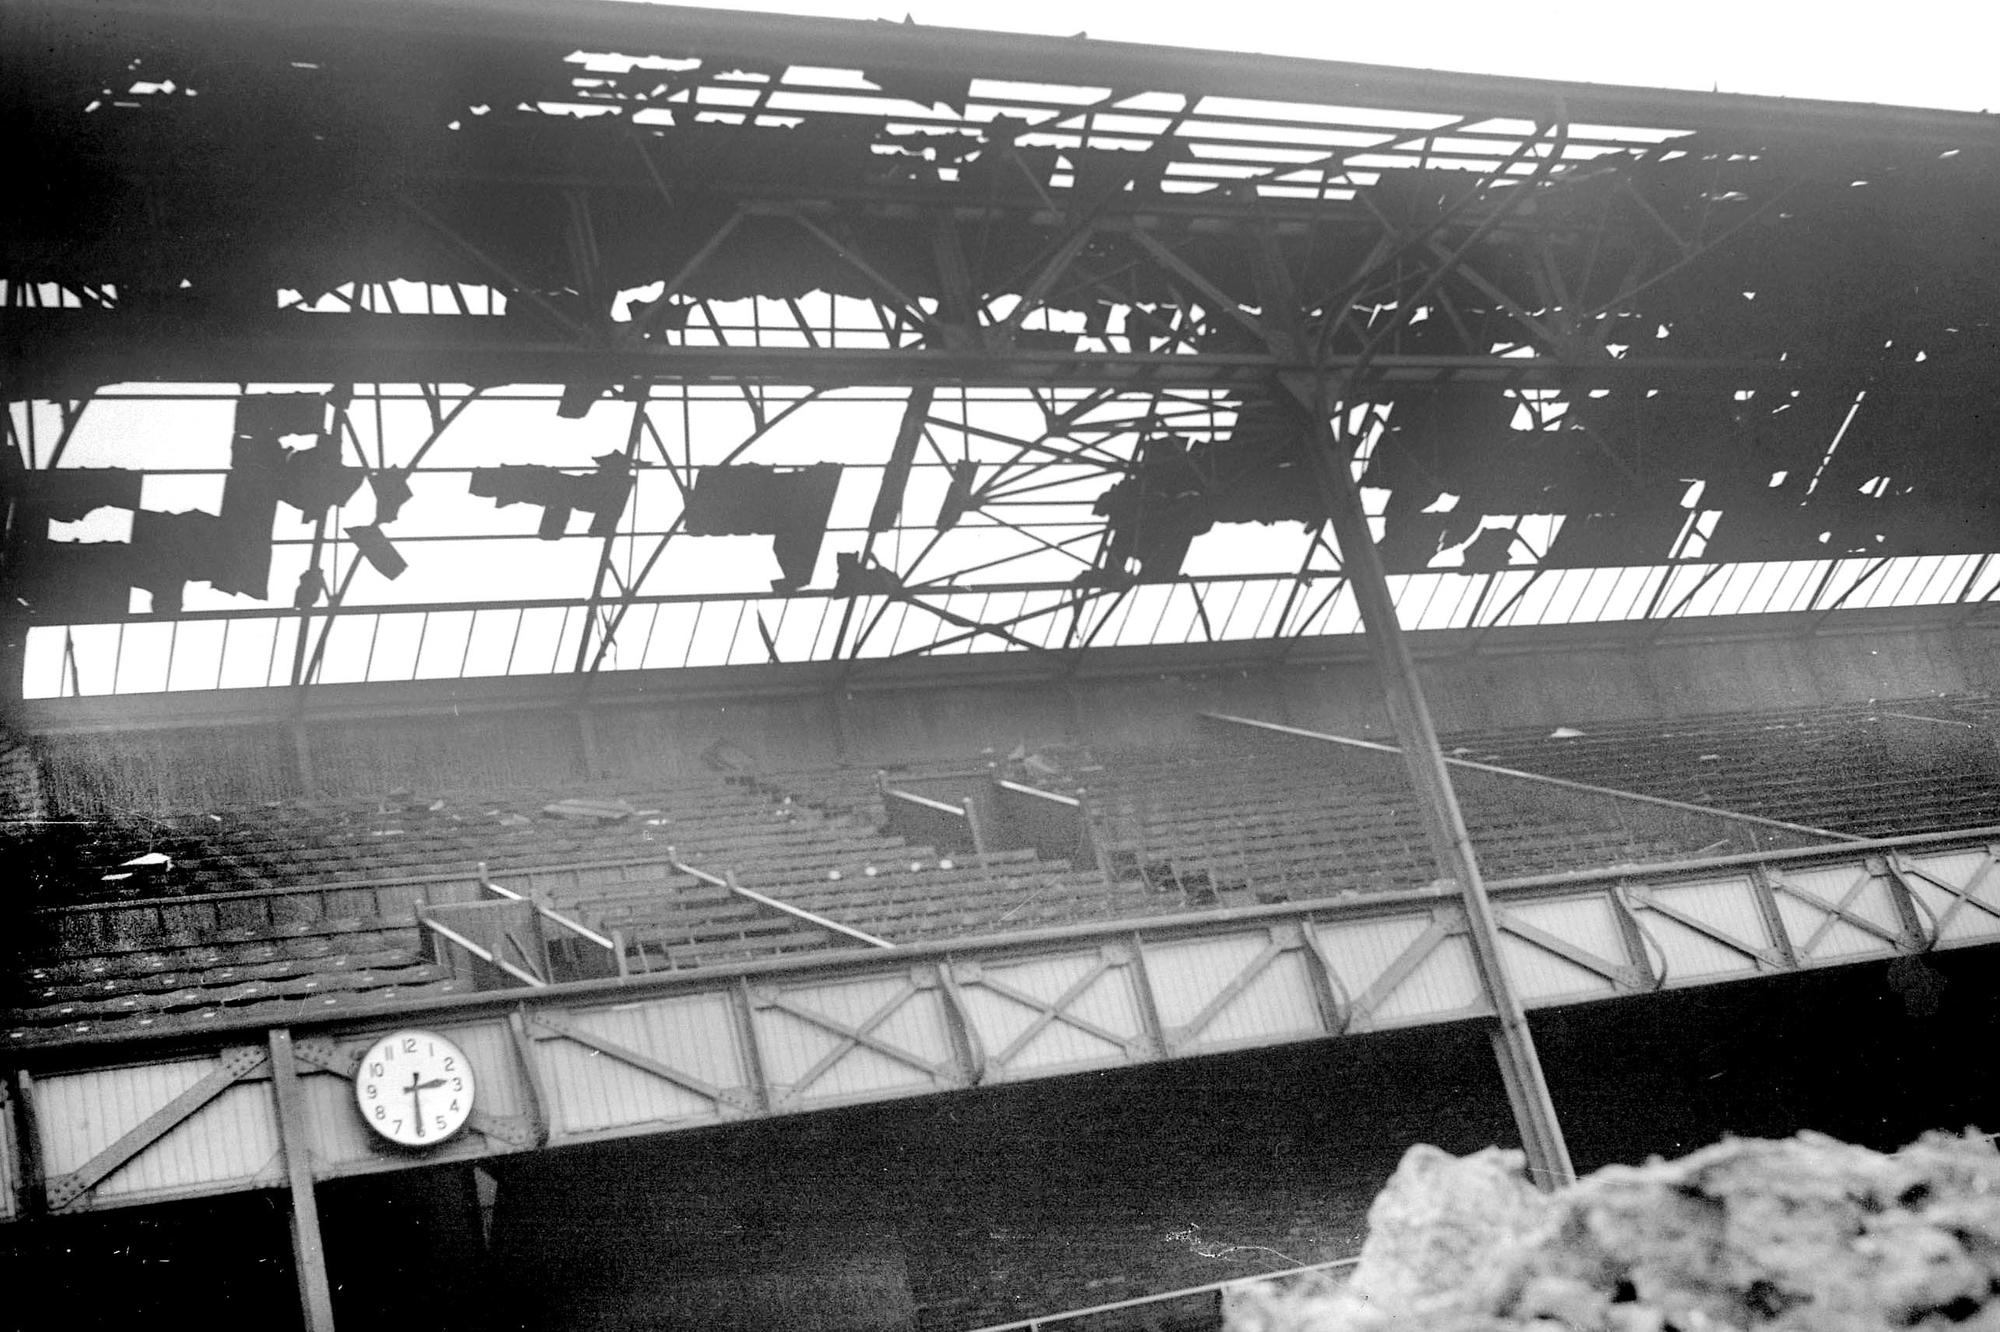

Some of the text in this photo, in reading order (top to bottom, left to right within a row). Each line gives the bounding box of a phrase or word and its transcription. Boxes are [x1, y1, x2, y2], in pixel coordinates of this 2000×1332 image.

[385, 1045, 394, 1060] 11
[402, 1038, 417, 1053] 12
[429, 1042, 434, 1057] 1
[369, 1062, 384, 1077] 10
[444, 1056, 455, 1071] 2
[367, 1084, 377, 1099] 9
[452, 1077, 462, 1092] 3
[375, 1104, 386, 1120] 8
[449, 1098, 459, 1112] 4
[392, 1119, 403, 1135] 7
[435, 1115, 447, 1130] 5
